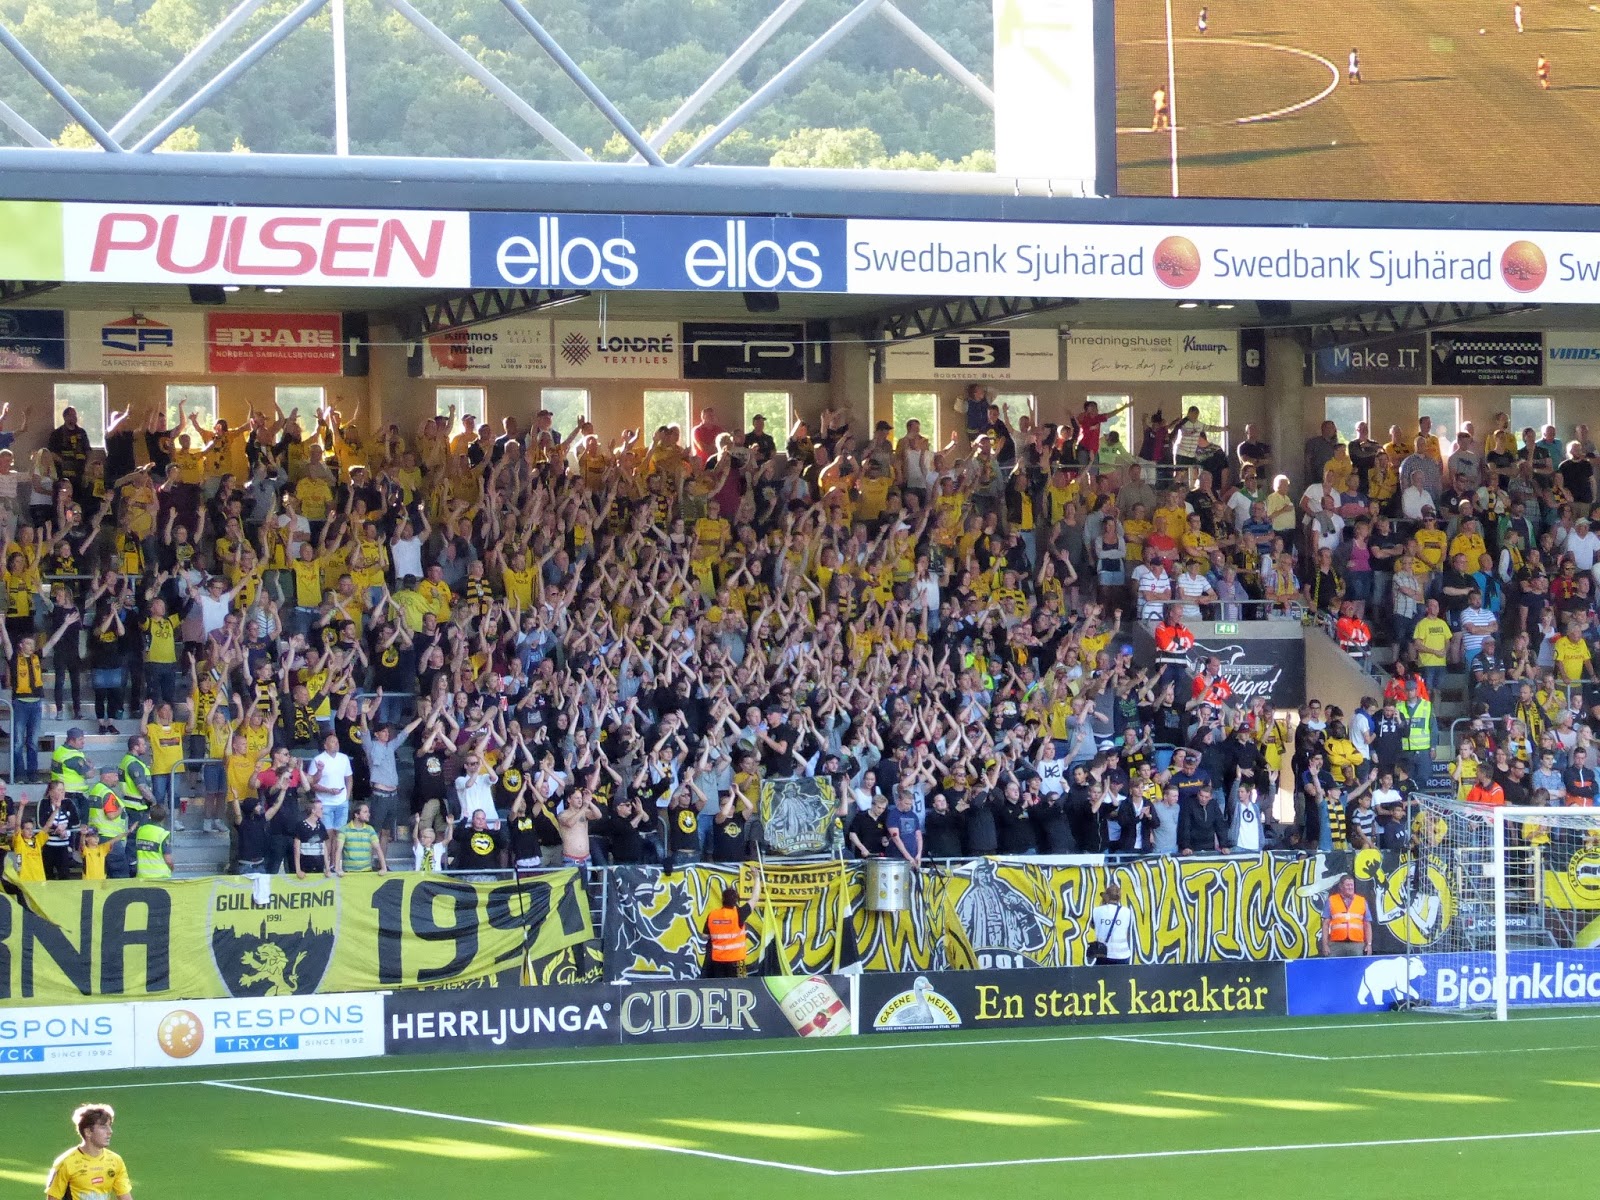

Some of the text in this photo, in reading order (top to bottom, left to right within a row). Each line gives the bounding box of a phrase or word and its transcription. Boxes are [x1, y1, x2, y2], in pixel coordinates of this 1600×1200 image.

[90, 212, 445, 278] PULSEN
[497, 217, 822, 288] ellos ellos
[854, 241, 1144, 281] Swedbank Sjuhärad
[1213, 248, 1492, 286] Swedbank Sjuhärad
[228, 328, 322, 348] PEAB
[597, 334, 674, 354] LONDRÉ
[102, 359, 113, 367] CA
[164, 360, 174, 368] AB
[603, 356, 669, 365] TEXTILES
[1334, 347, 1419, 368] Make IT
[744, 867, 841, 885] SLIDARITE
[216, 889, 335, 912] GULIANERNA
[1050, 852, 1306, 967] FNATICS
[266, 914, 282, 923] 1991
[1100, 918, 1122, 926] FOO
[371, 877, 585, 985] 1991
[0, 887, 172, 1000] NA
[794, 991, 828, 1022] CIDER
[927, 995, 957, 1021] MEJERI
[975, 976, 1269, 1021] En stark karaktär
[214, 1004, 364, 1029] RESPONS
[621, 987, 760, 1036] CIDER
[0, 1016, 113, 1040] SPONS
[50, 1049, 113, 1059] SINCE 1992
[225, 1036, 289, 1050] TRYCK
[305, 1037, 365, 1047] SINCE 1992
